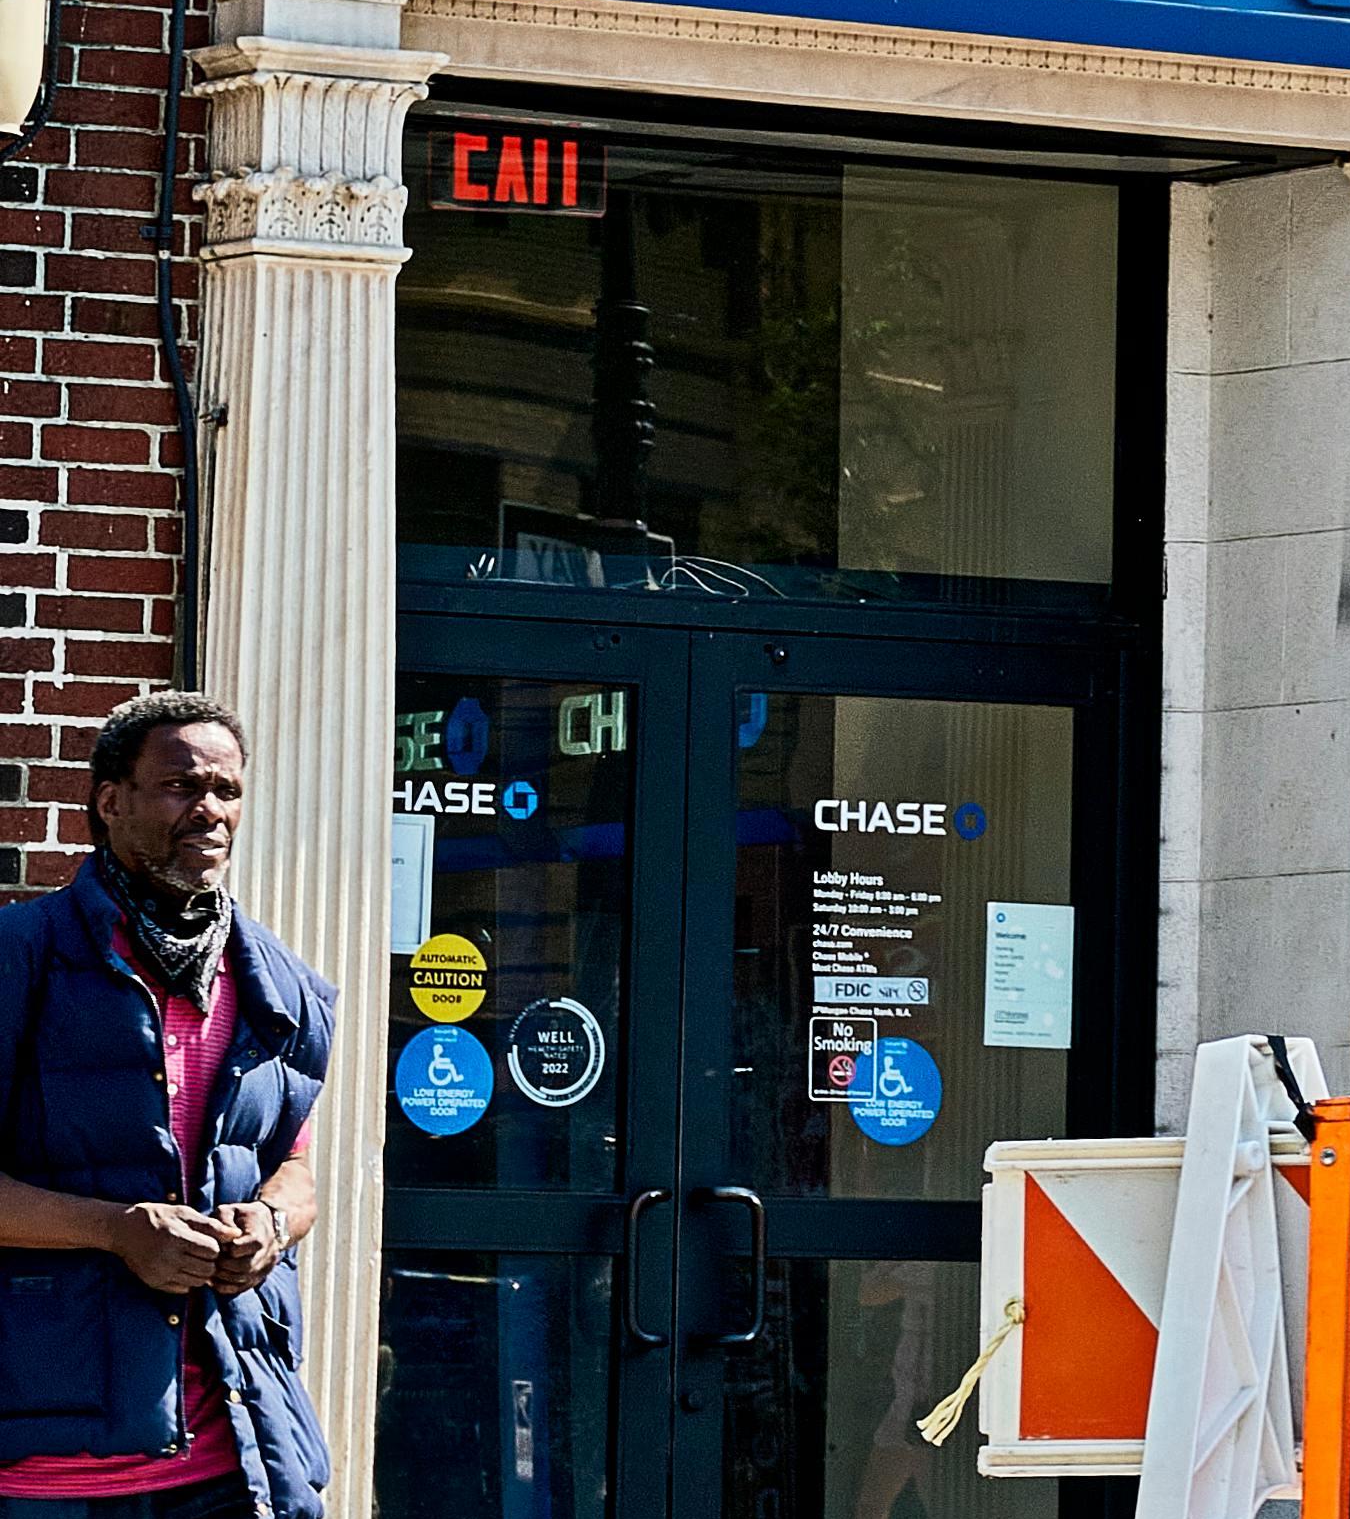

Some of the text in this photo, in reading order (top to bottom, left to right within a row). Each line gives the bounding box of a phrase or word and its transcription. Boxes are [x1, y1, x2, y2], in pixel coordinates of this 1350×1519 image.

[393, 779, 497, 815] HASE
[814, 799, 948, 836] CHASE
[813, 870, 884, 888] Lobby Hours
[812, 923, 913, 940] 24/7 Convenience
[419, 953, 478, 966] AUTOMATIC
[413, 971, 483, 987] CAUTION
[834, 982, 872, 998] FDIC
[432, 993, 462, 1004] DOOR
[537, 1031, 575, 1044] WELL
[832, 1022, 854, 1038] No
[813, 1036, 872, 1056] Smoking
[541, 1062, 569, 1075] 2022
[430, 1107, 457, 1116] DOOR
